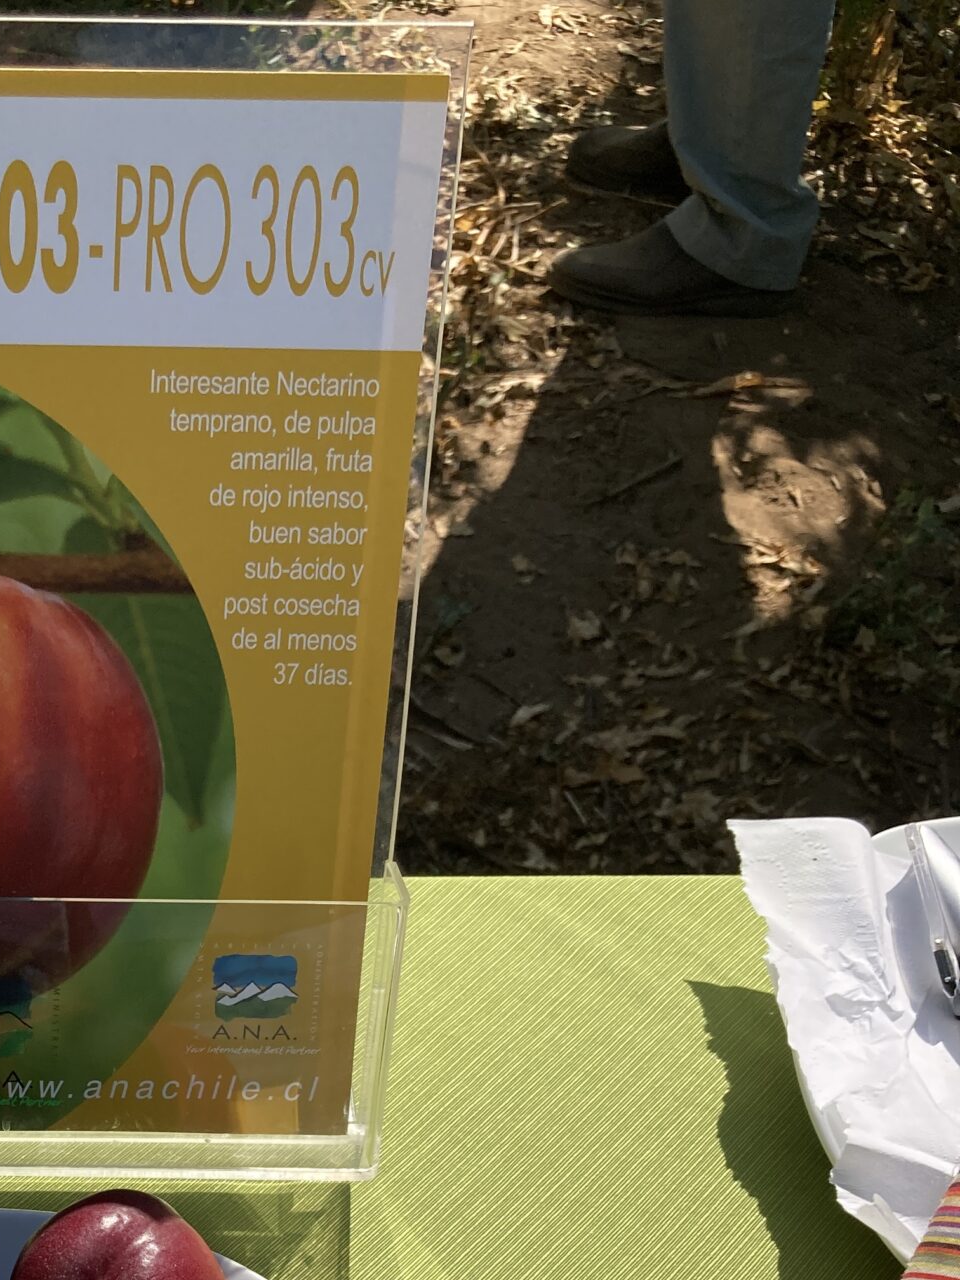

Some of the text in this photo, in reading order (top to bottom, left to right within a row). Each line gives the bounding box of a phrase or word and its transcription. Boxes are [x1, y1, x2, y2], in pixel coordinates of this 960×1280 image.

[150, 369, 380, 398] Interesante Nectarino
[170, 408, 376, 440] temprano, de pulpa
[230, 447, 373, 474] amarilla, fruta
[210, 484, 369, 513] de rojo intenso,
[249, 521, 368, 545] buen sabor
[244, 557, 364, 587] sub-ácido y
[224, 594, 360, 619] post cosecha
[232, 628, 357, 651] de al menos
[273, 663, 353, 686] 37 días.
[212, 1025, 297, 1041] A.N.A.
